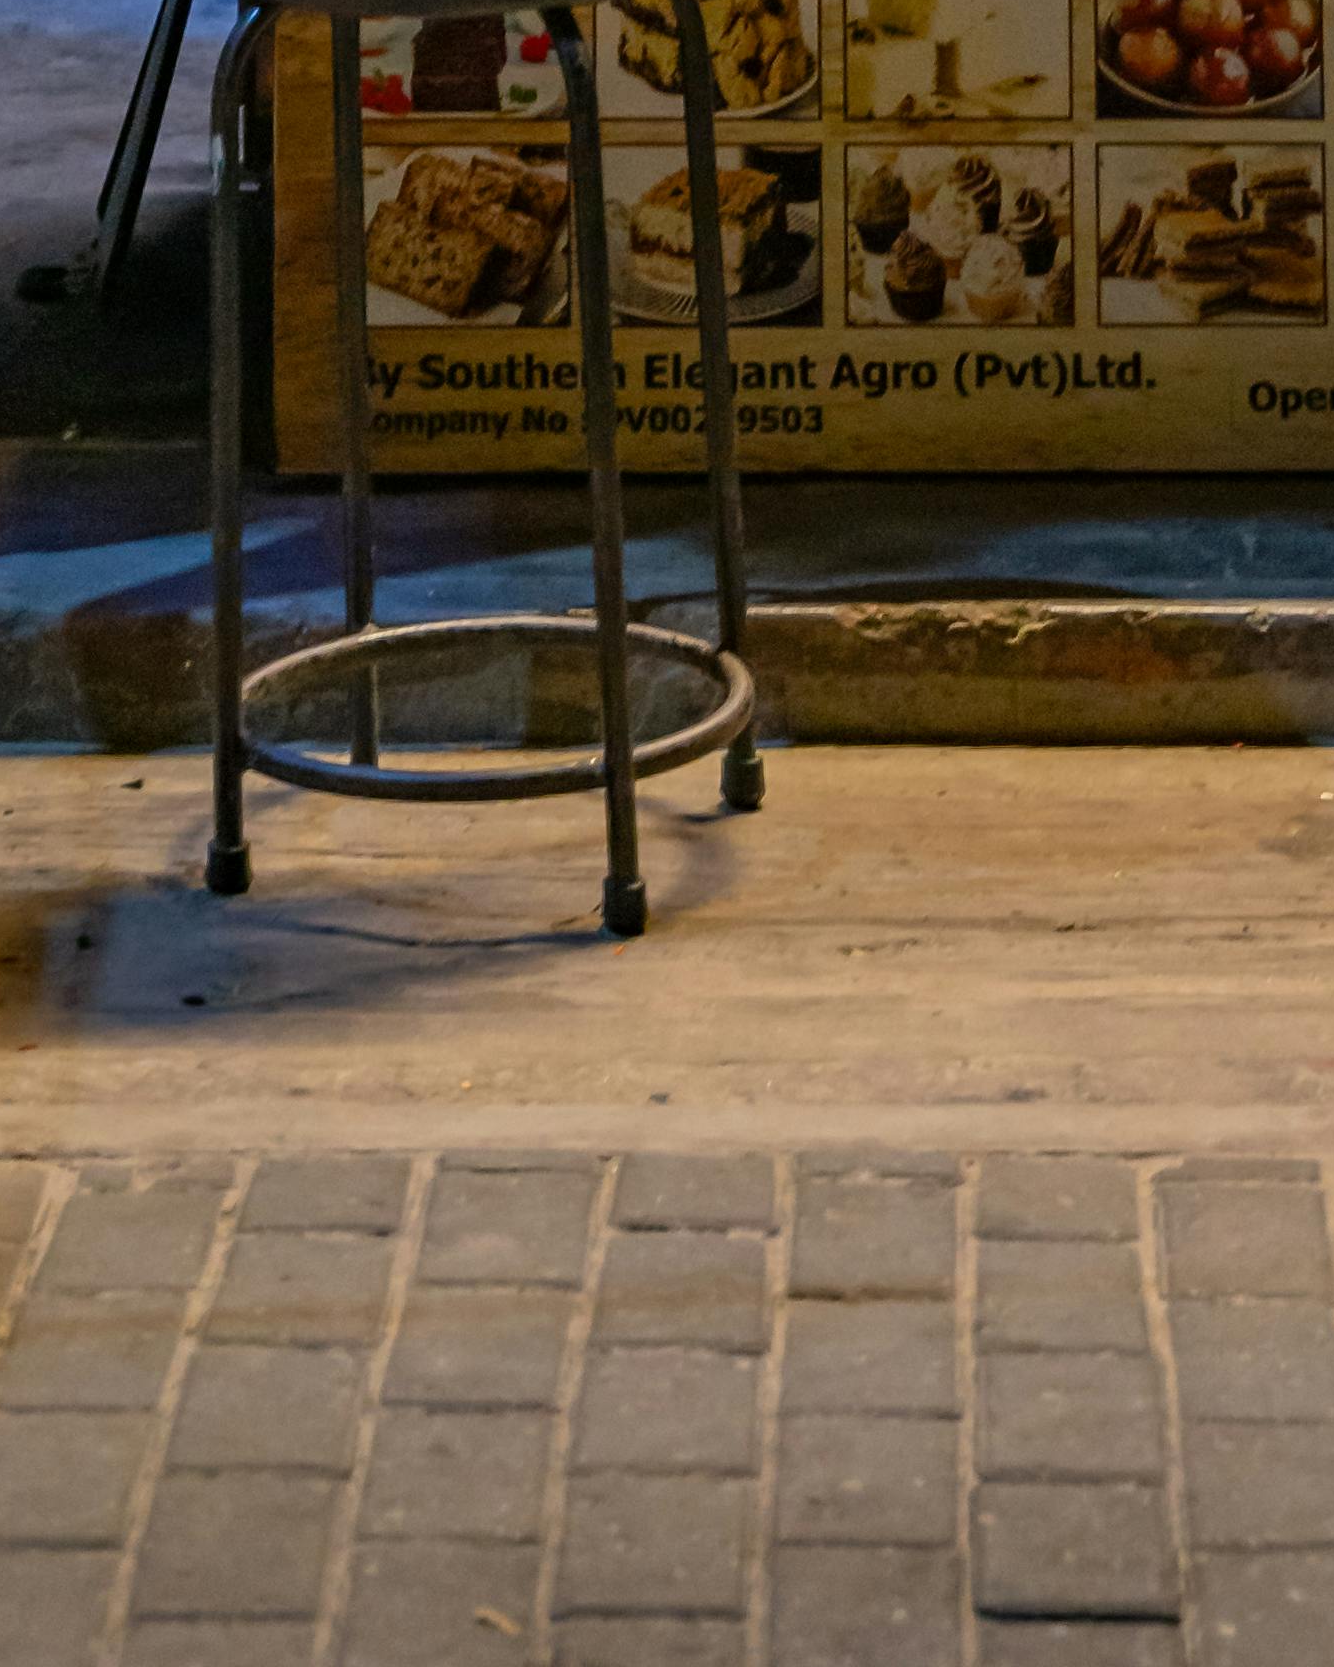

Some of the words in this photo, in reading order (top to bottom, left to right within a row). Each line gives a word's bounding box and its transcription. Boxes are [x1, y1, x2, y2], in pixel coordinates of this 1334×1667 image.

[417, 352, 626, 391] Southen
[829, 354, 939, 398] Agro
[370, 405, 511, 442] ompany
[521, 405, 568, 435] No
